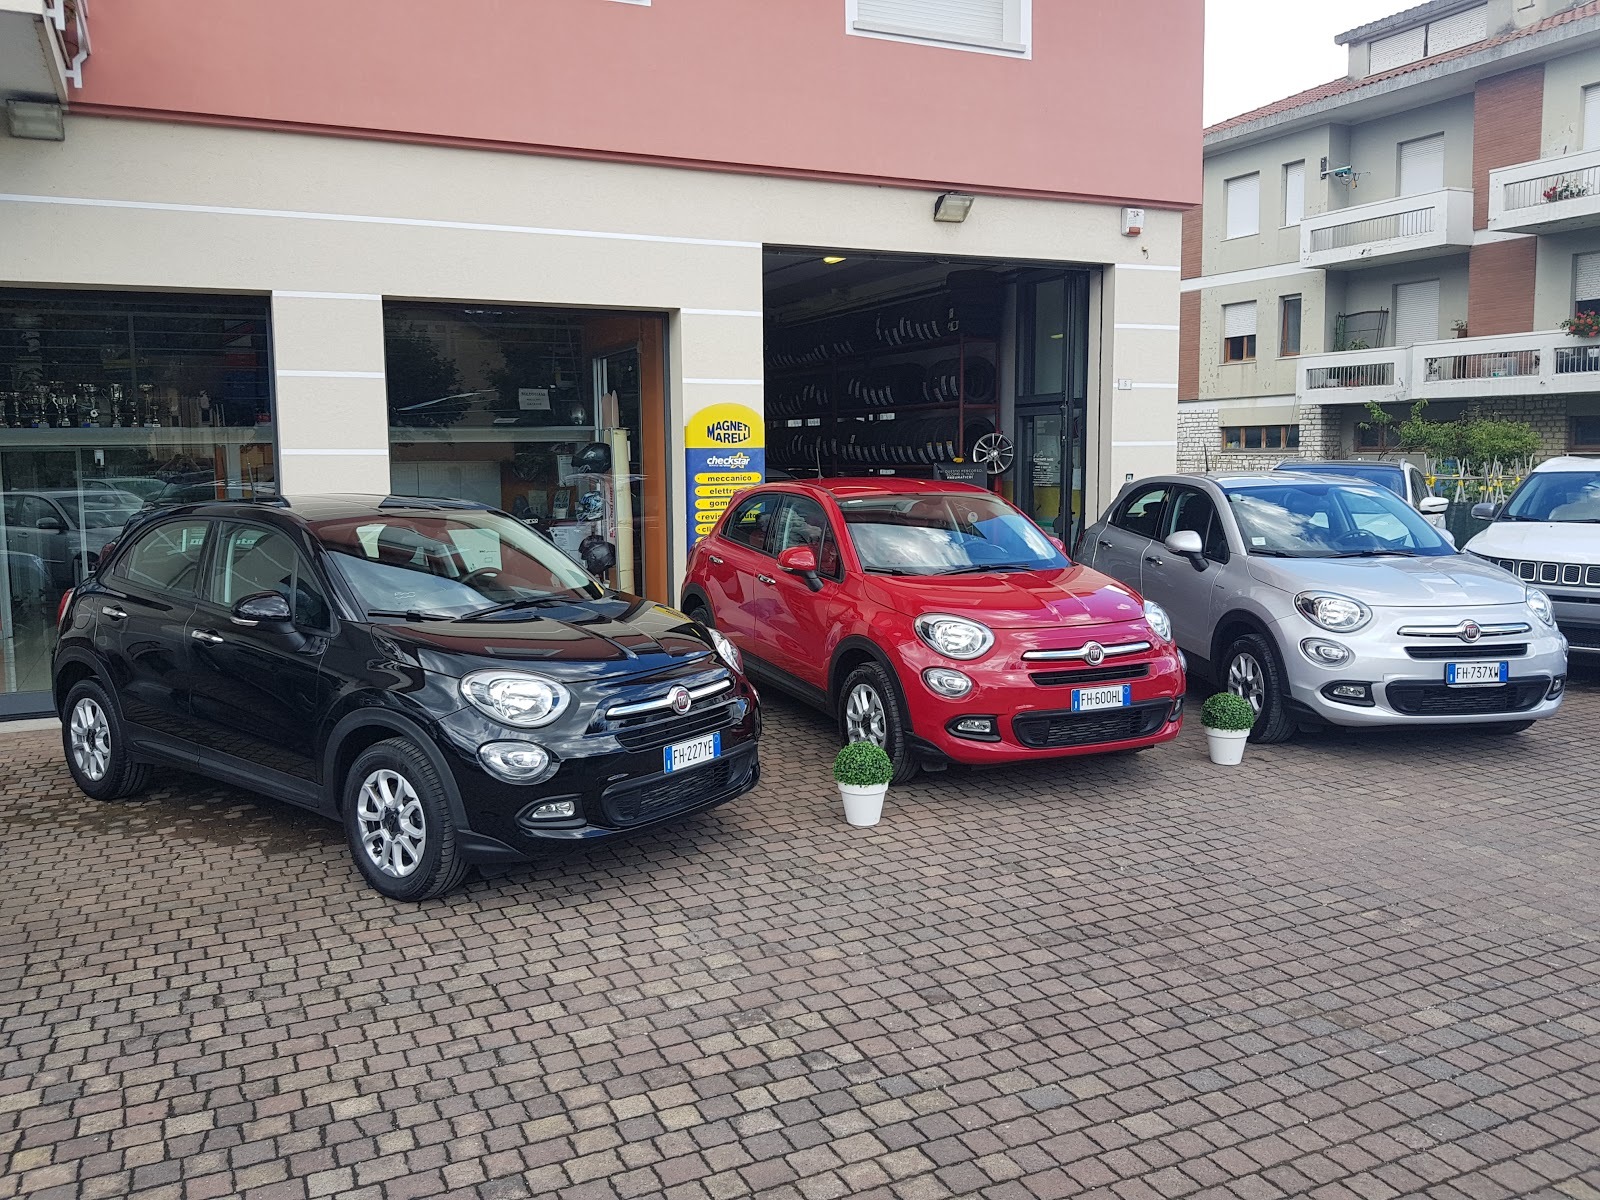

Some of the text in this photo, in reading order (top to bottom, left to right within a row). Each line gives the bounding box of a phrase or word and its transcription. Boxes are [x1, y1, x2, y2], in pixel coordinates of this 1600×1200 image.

[707, 420, 750, 436] MAGNETI
[707, 430, 750, 444] MARELLI
[706, 456, 750, 466] checkstar
